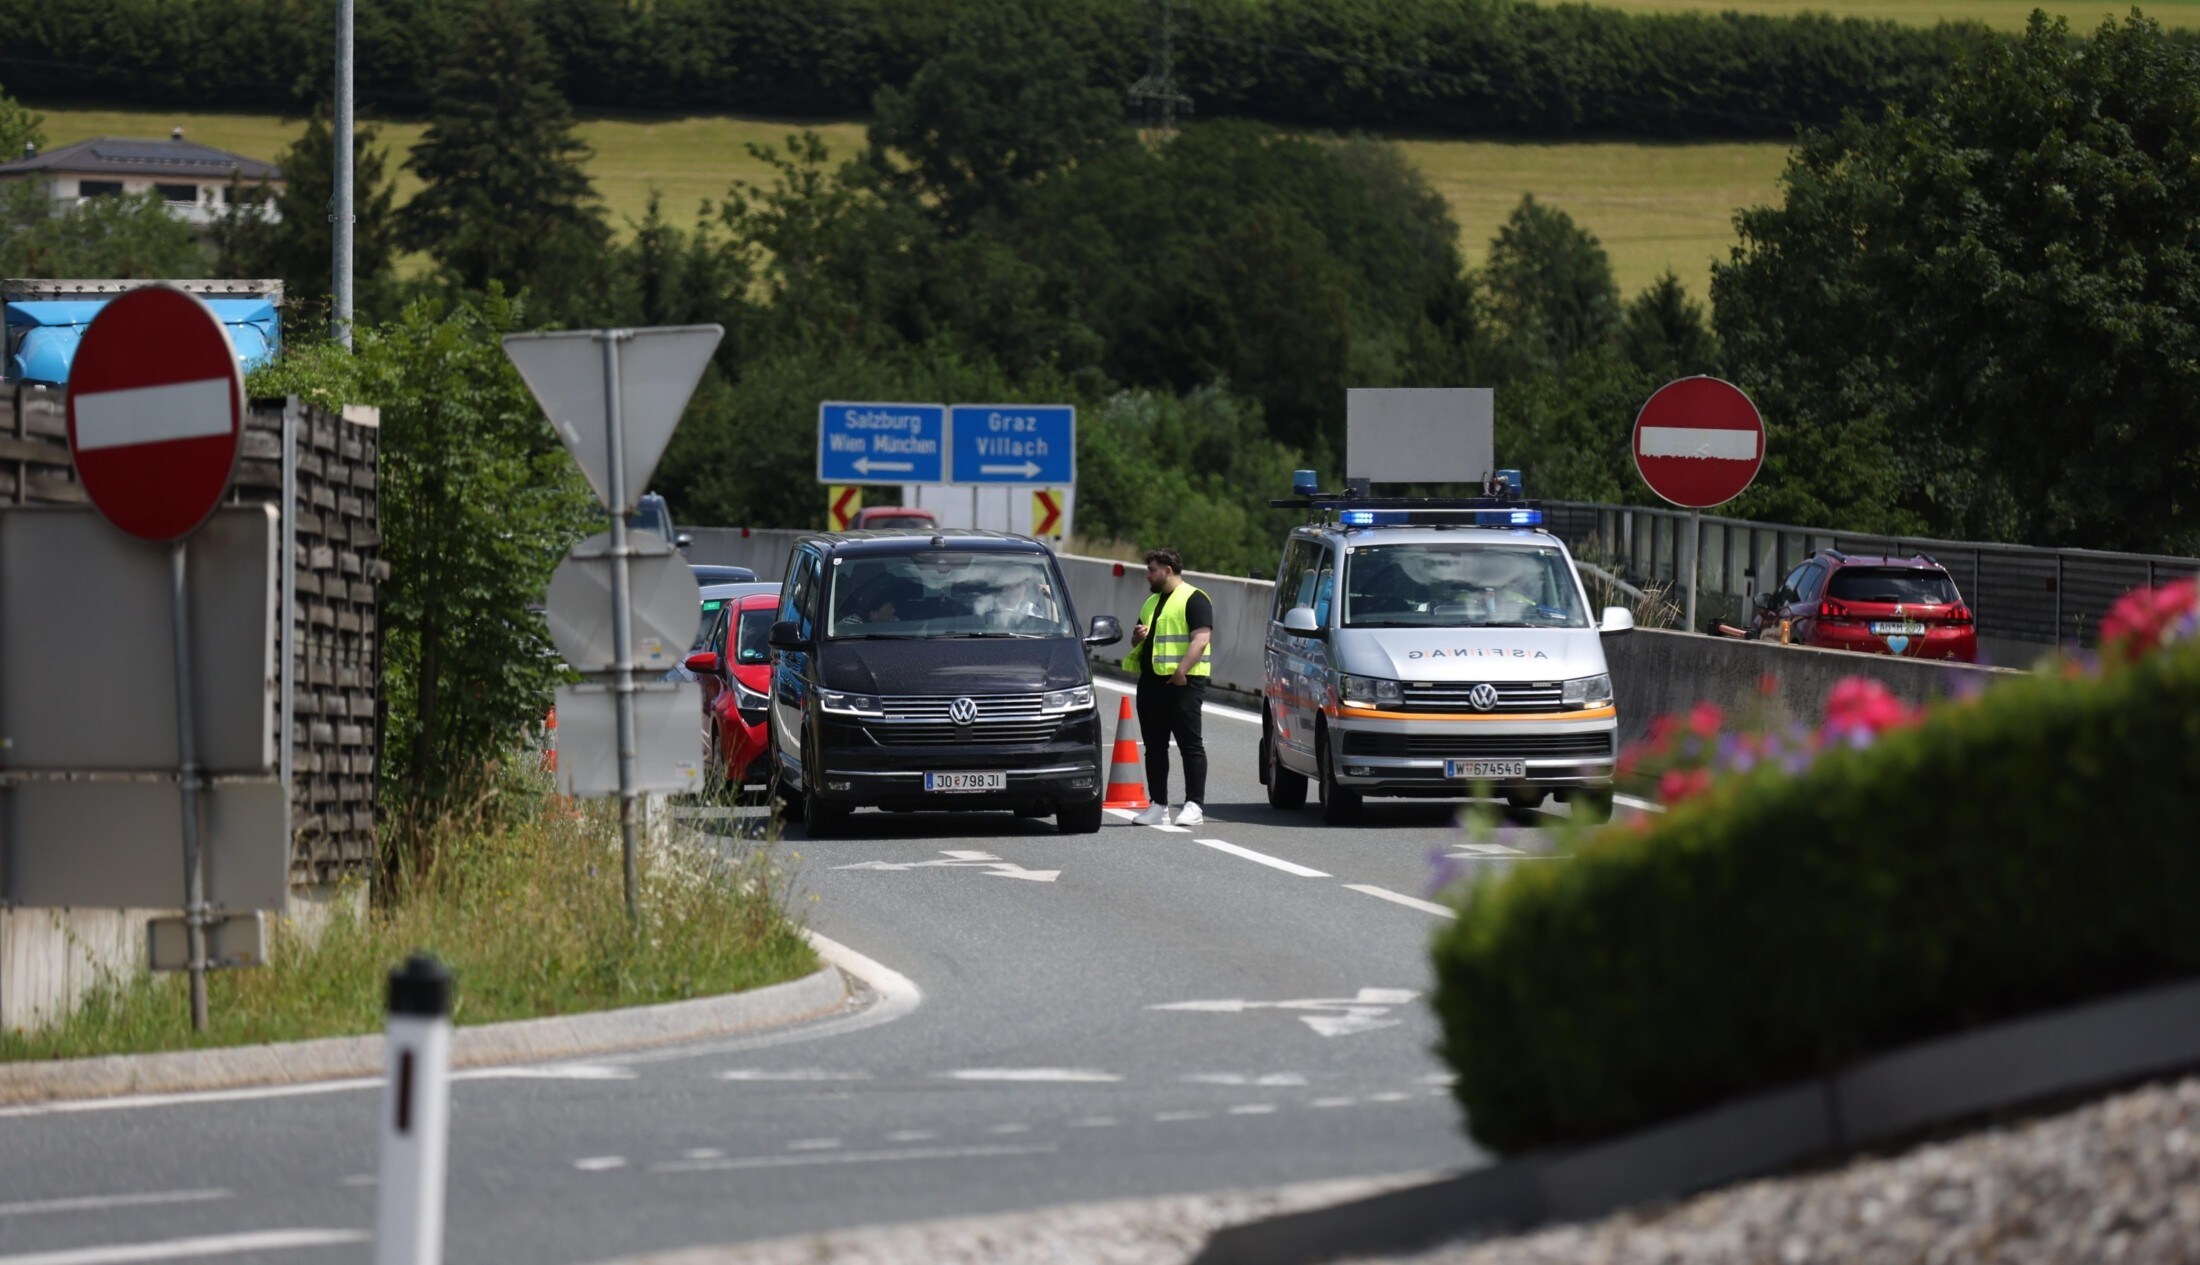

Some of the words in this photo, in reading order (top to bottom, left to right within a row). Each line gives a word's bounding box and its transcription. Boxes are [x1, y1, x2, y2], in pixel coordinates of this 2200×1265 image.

[845, 409, 922, 434] Salzburg
[988, 411, 1037, 432] Graz
[829, 433, 867, 452] Wien
[872, 433, 937, 454] München
[976, 436, 1049, 457] Villach
[1455, 763, 1465, 775] W
[937, 775, 953, 788] JO
[962, 774, 985, 787] 798
[987, 774, 1000, 787] JI
